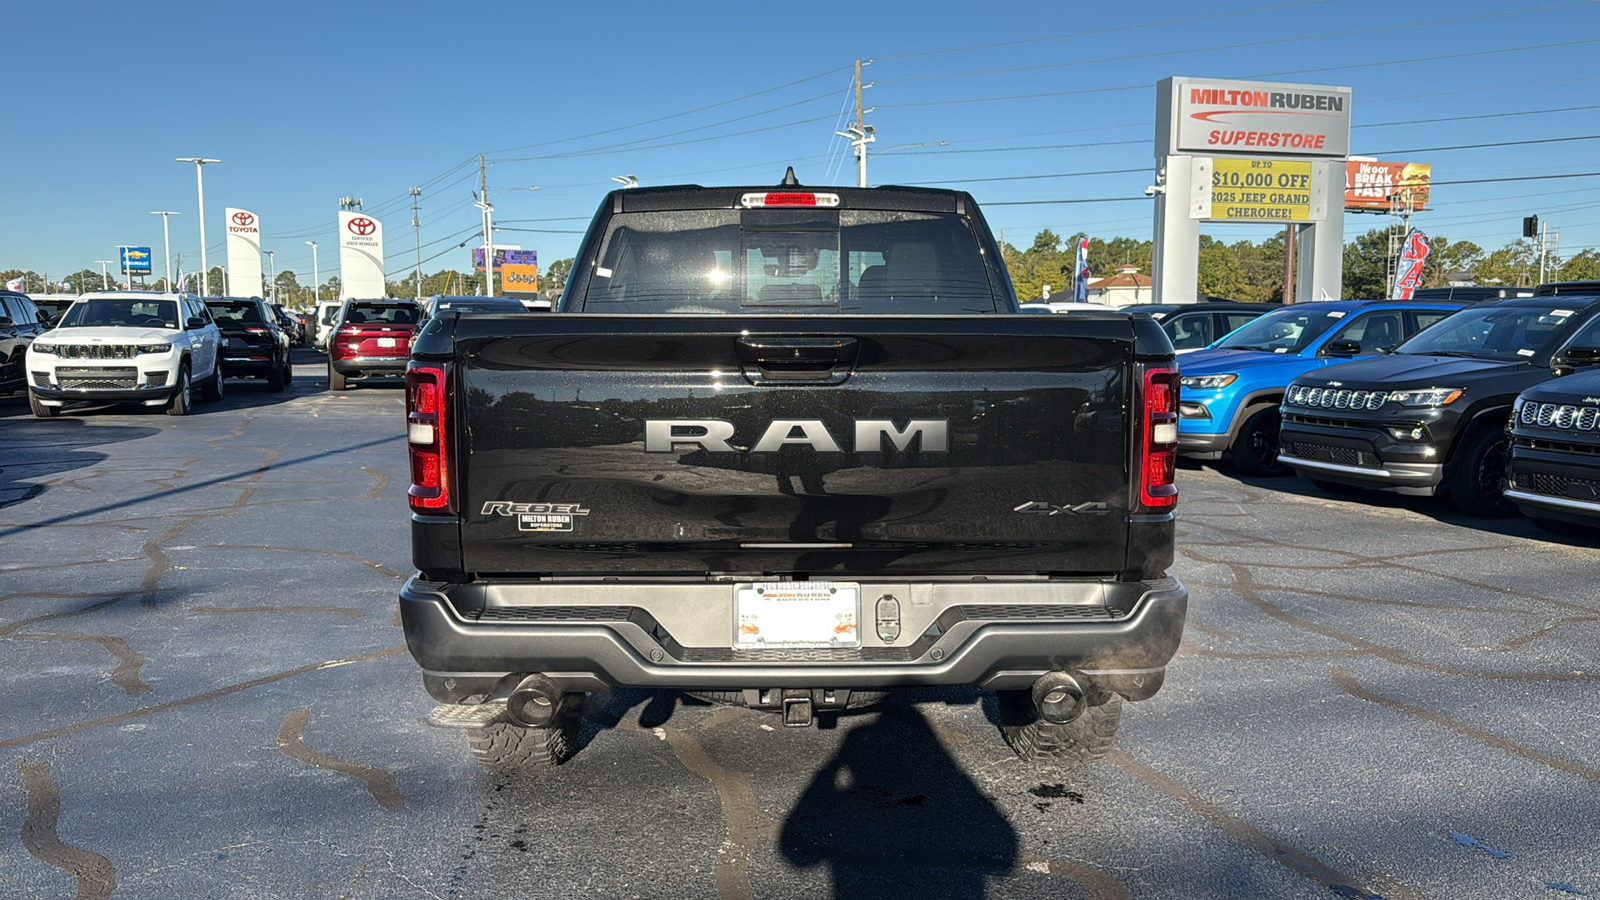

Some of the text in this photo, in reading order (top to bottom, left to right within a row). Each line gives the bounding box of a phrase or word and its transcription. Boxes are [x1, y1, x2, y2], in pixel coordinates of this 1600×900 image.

[1207, 130, 1326, 149] SUPERSTORE
[1262, 161, 1273, 169] TO
[1371, 166, 1389, 174] GOT
[1212, 171, 1309, 189] $10,000 OFF
[1355, 173, 1393, 184] BREAK
[1354, 184, 1392, 197] FAST
[1211, 192, 1309, 204] 2025 JEEP GRAND
[1226, 207, 1292, 218] CHEROKEE!
[507, 271, 535, 284] Jeep
[644, 418, 950, 453] RAM
[481, 501, 590, 516] REBEL
